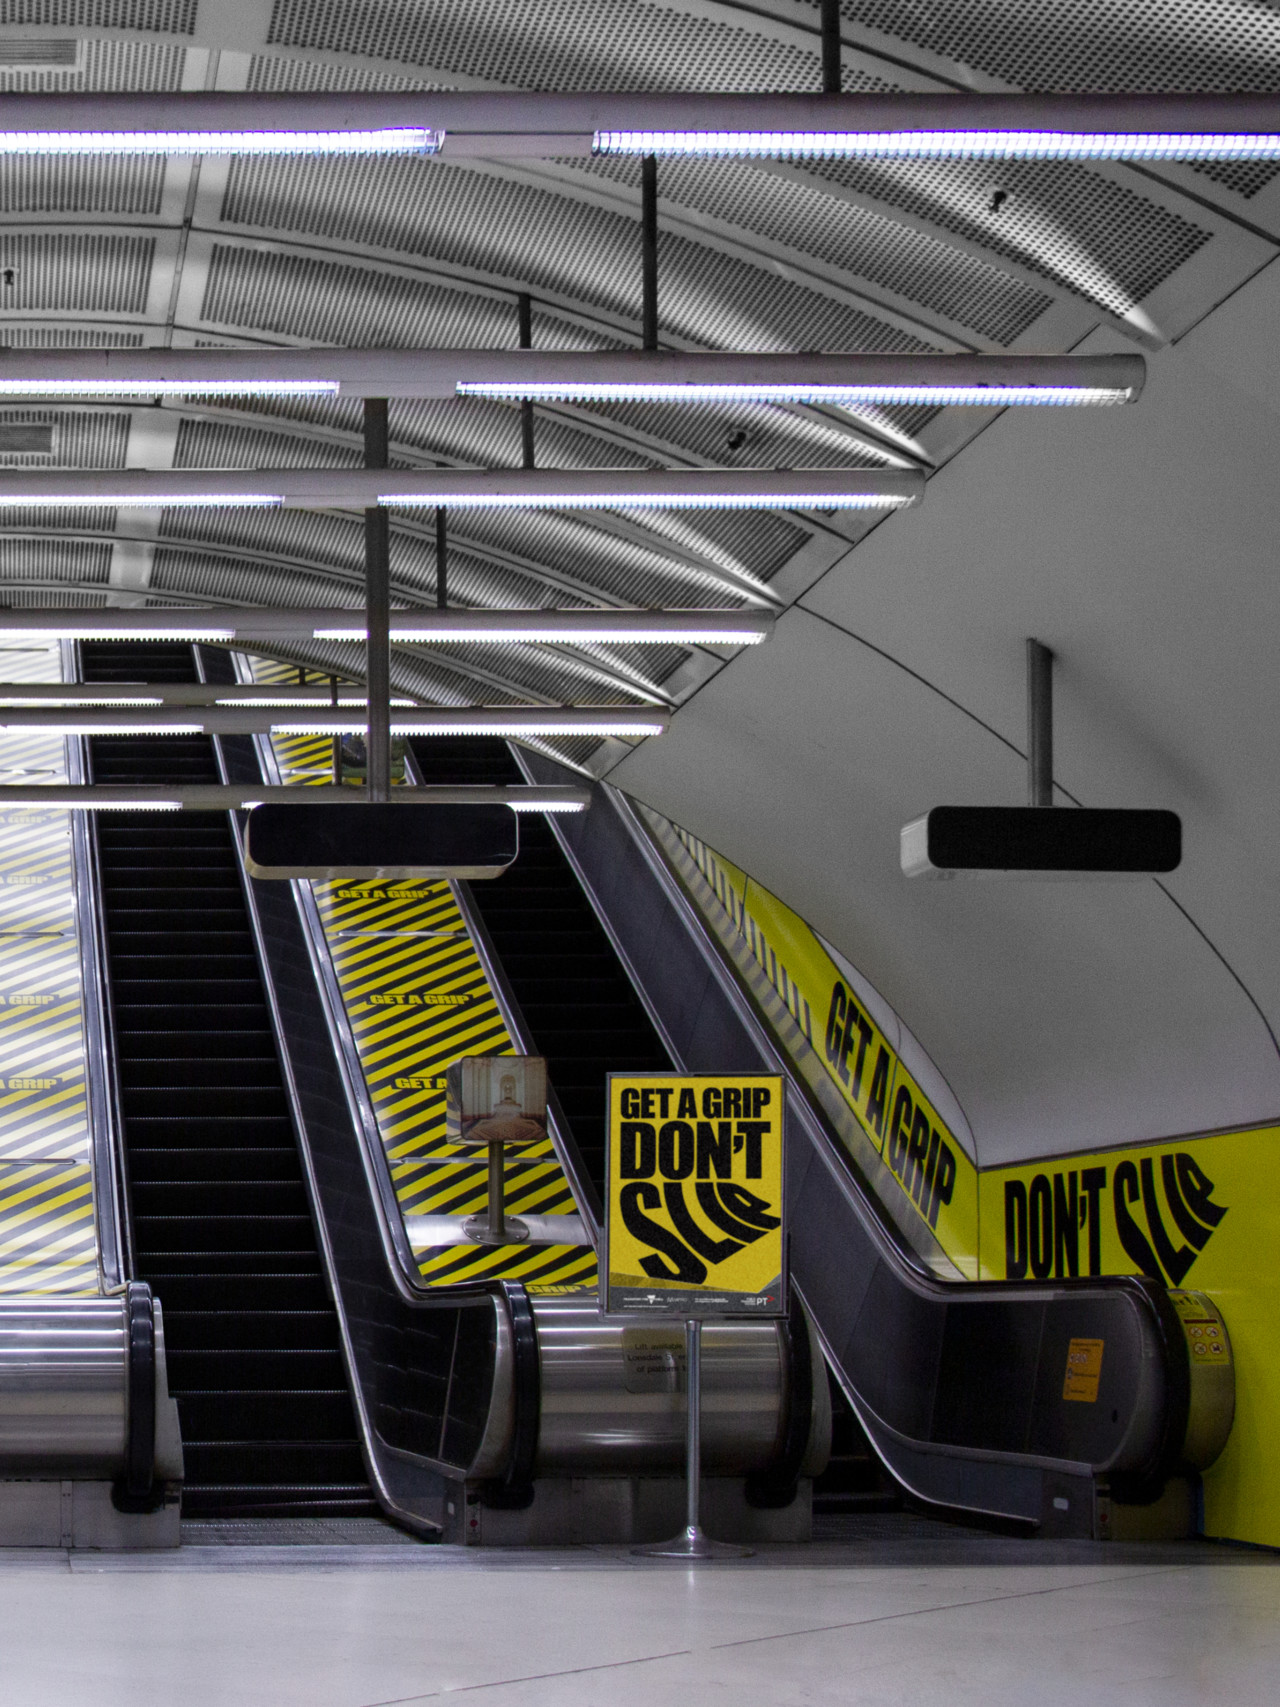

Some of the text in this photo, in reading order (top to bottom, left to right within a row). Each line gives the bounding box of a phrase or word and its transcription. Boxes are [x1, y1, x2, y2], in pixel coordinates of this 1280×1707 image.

[337, 889, 429, 899] GET A GRIP
[8, 995, 55, 1005] GRIP
[369, 994, 470, 1005] GET A GRIP
[8, 1078, 57, 1090] GRIP
[394, 1077, 433, 1089] GET
[620, 1087, 771, 1120] GET A GRIP
[824, 980, 957, 1231] GET A GRIP
[620, 1120, 772, 1181] DON'T
[1004, 1152, 1229, 1287] DON'T SLIP
[620, 1181, 782, 1285] SLIP
[524, 1285, 582, 1293] GRIP
